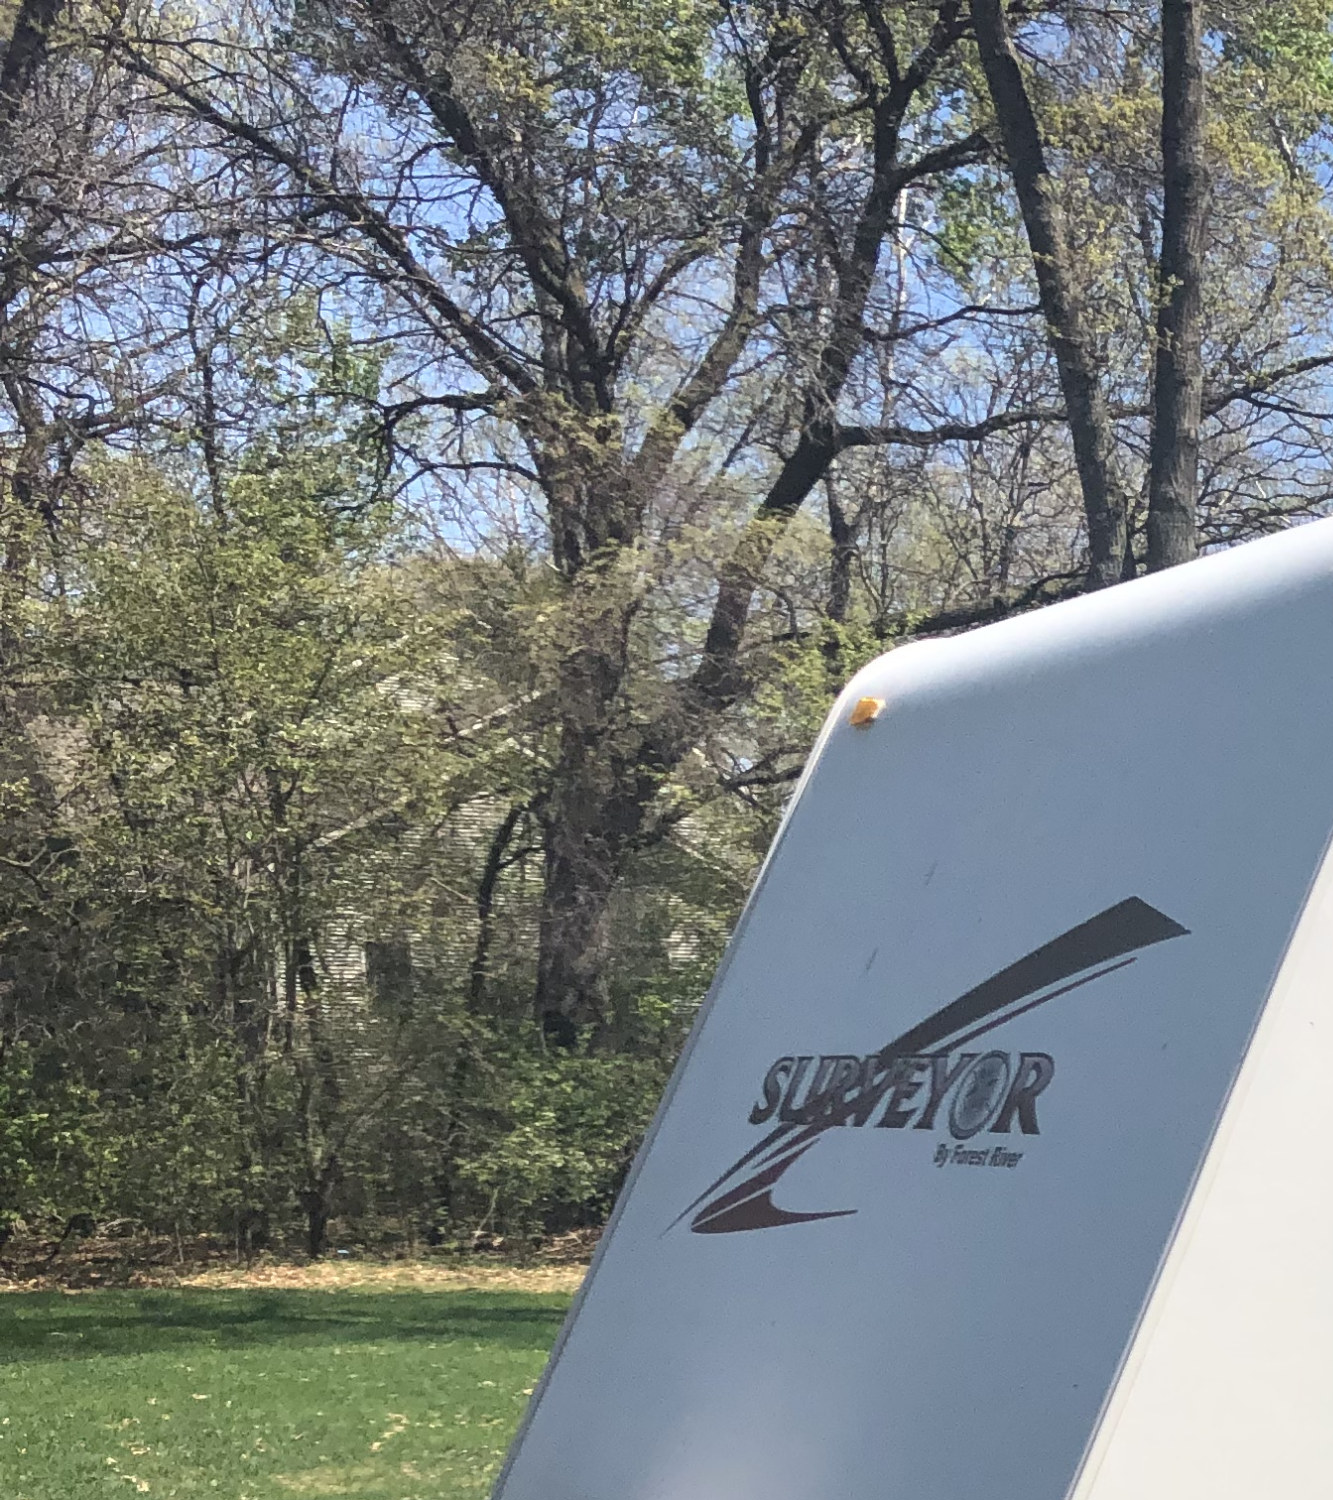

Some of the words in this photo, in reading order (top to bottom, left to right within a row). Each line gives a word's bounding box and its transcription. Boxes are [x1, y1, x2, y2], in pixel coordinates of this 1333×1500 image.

[748, 1050, 1055, 1140] SURVEYOR
[933, 1143, 949, 1168] By
[949, 1144, 991, 1167] Forest
[988, 1147, 1024, 1169] River
